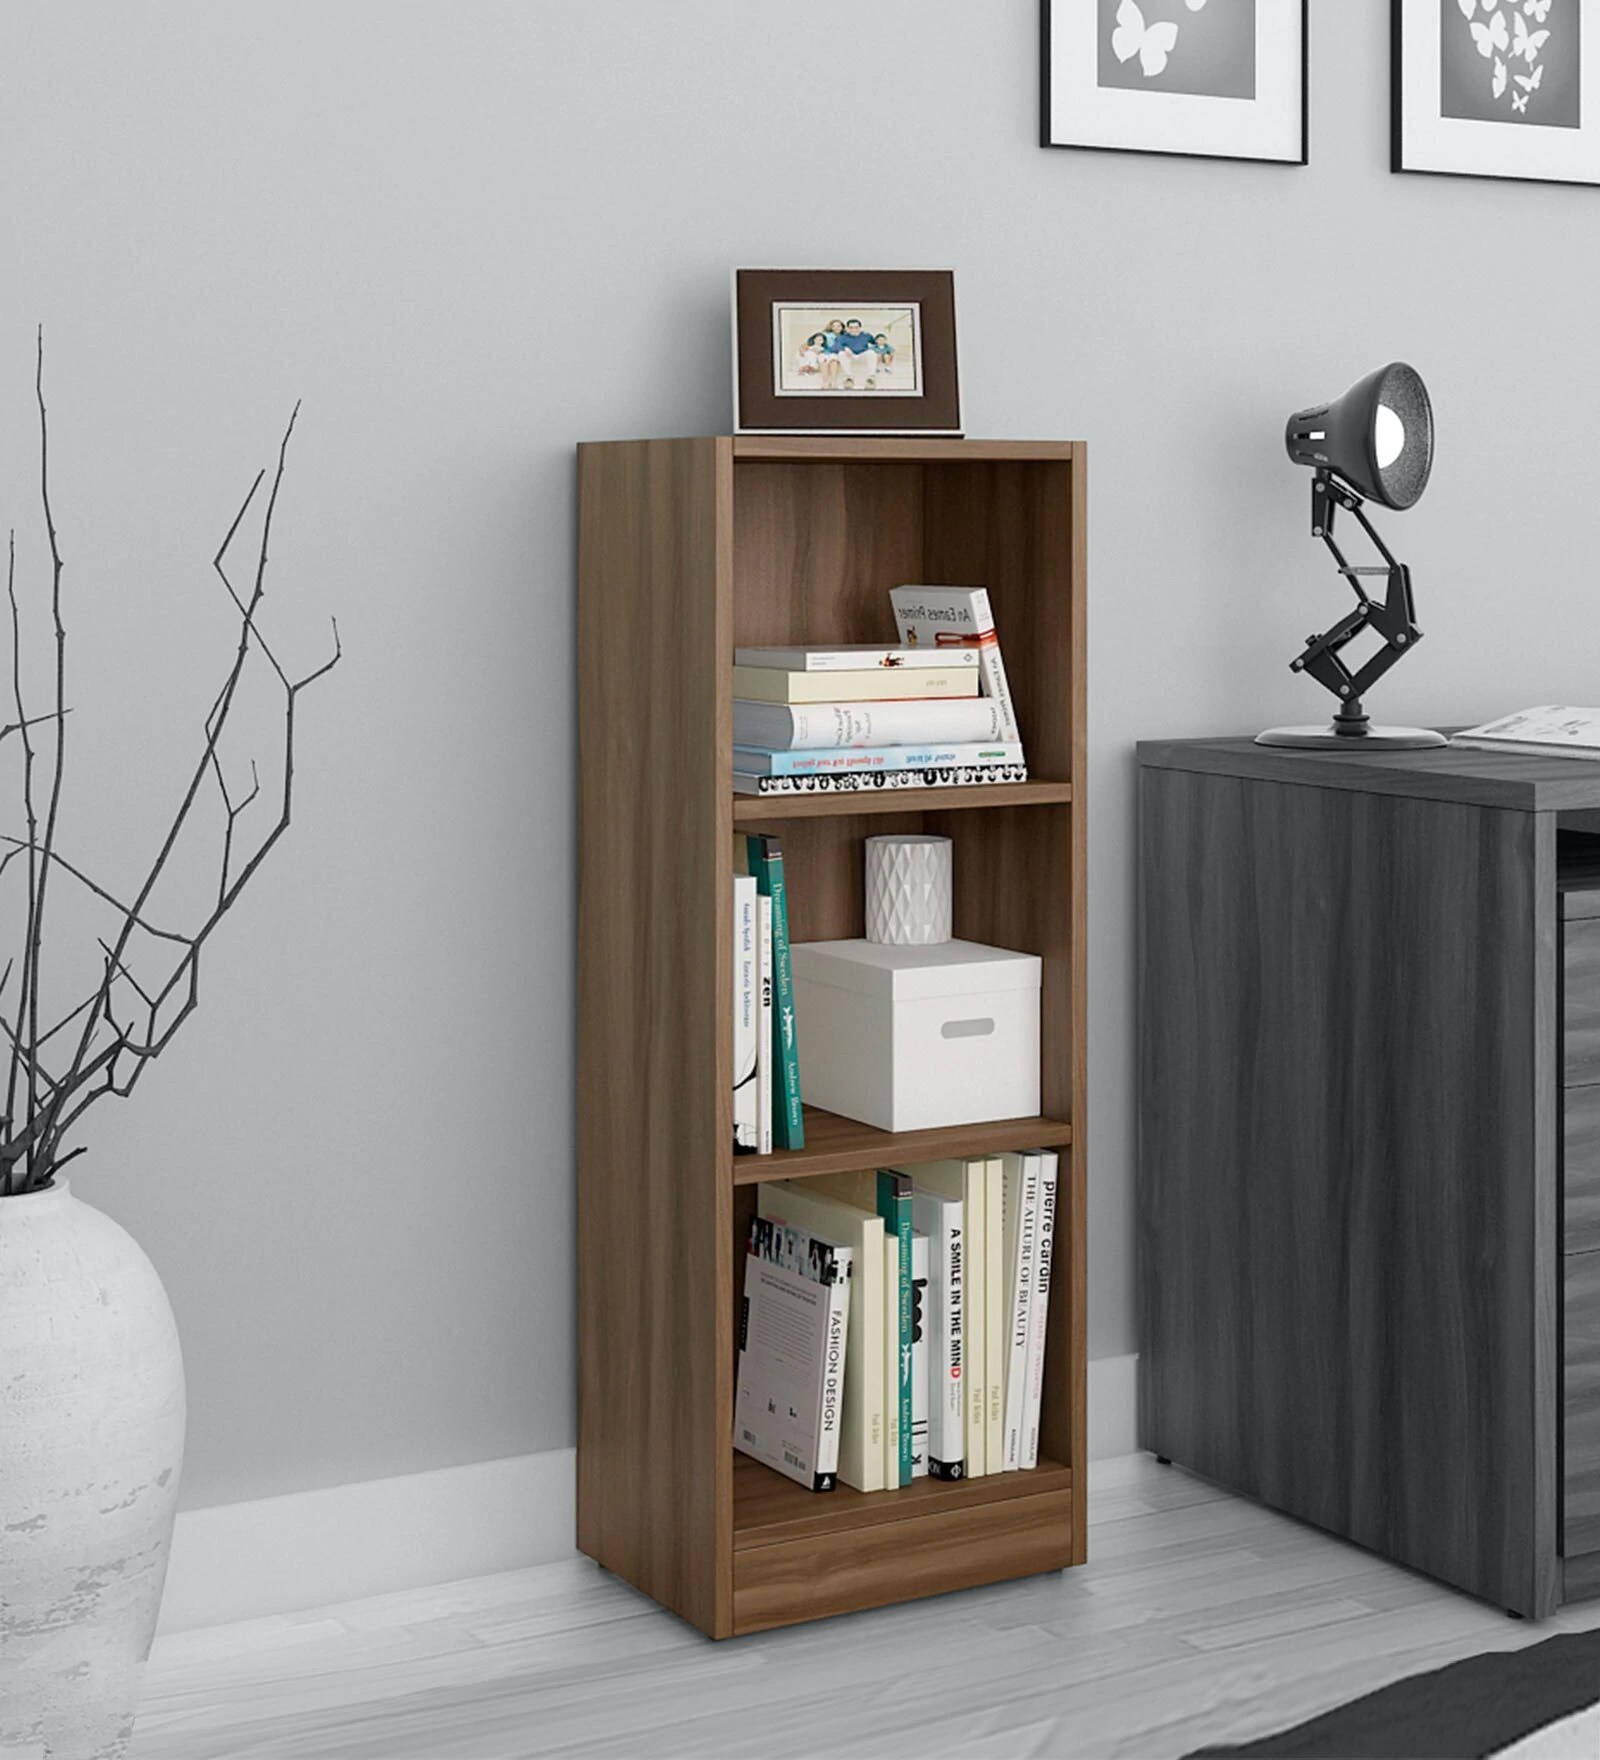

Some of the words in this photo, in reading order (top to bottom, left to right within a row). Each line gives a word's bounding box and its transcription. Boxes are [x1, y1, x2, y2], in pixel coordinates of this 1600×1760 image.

[772, 883, 785, 936] Dreaming
[777, 938, 787, 951] of
[763, 977, 771, 1007] zen
[779, 953, 789, 995] Sweden
[788, 1060, 797, 1095] Andrew
[791, 1097, 799, 1126] Brown
[1026, 1175, 1036, 1204] THE
[1043, 1180, 1055, 1233] pierre
[901, 1222, 911, 1275] Dreaming
[951, 1228, 961, 1238] A
[1022, 1206, 1034, 1265] ALLURE
[951, 1242, 961, 1286] SMILE
[1020, 1266, 1031, 1288] OF
[1038, 1238, 1052, 1294] cardin
[901, 1291, 911, 1332] Sweden
[951, 1290, 961, 1305] IN
[951, 1309, 961, 1335] THE
[1015, 1290, 1028, 1349] BEAUTY
[828, 1310, 842, 1374] FASHION
[951, 1339, 961, 1379] MIND
[824, 1378, 838, 1431] DESIGN
